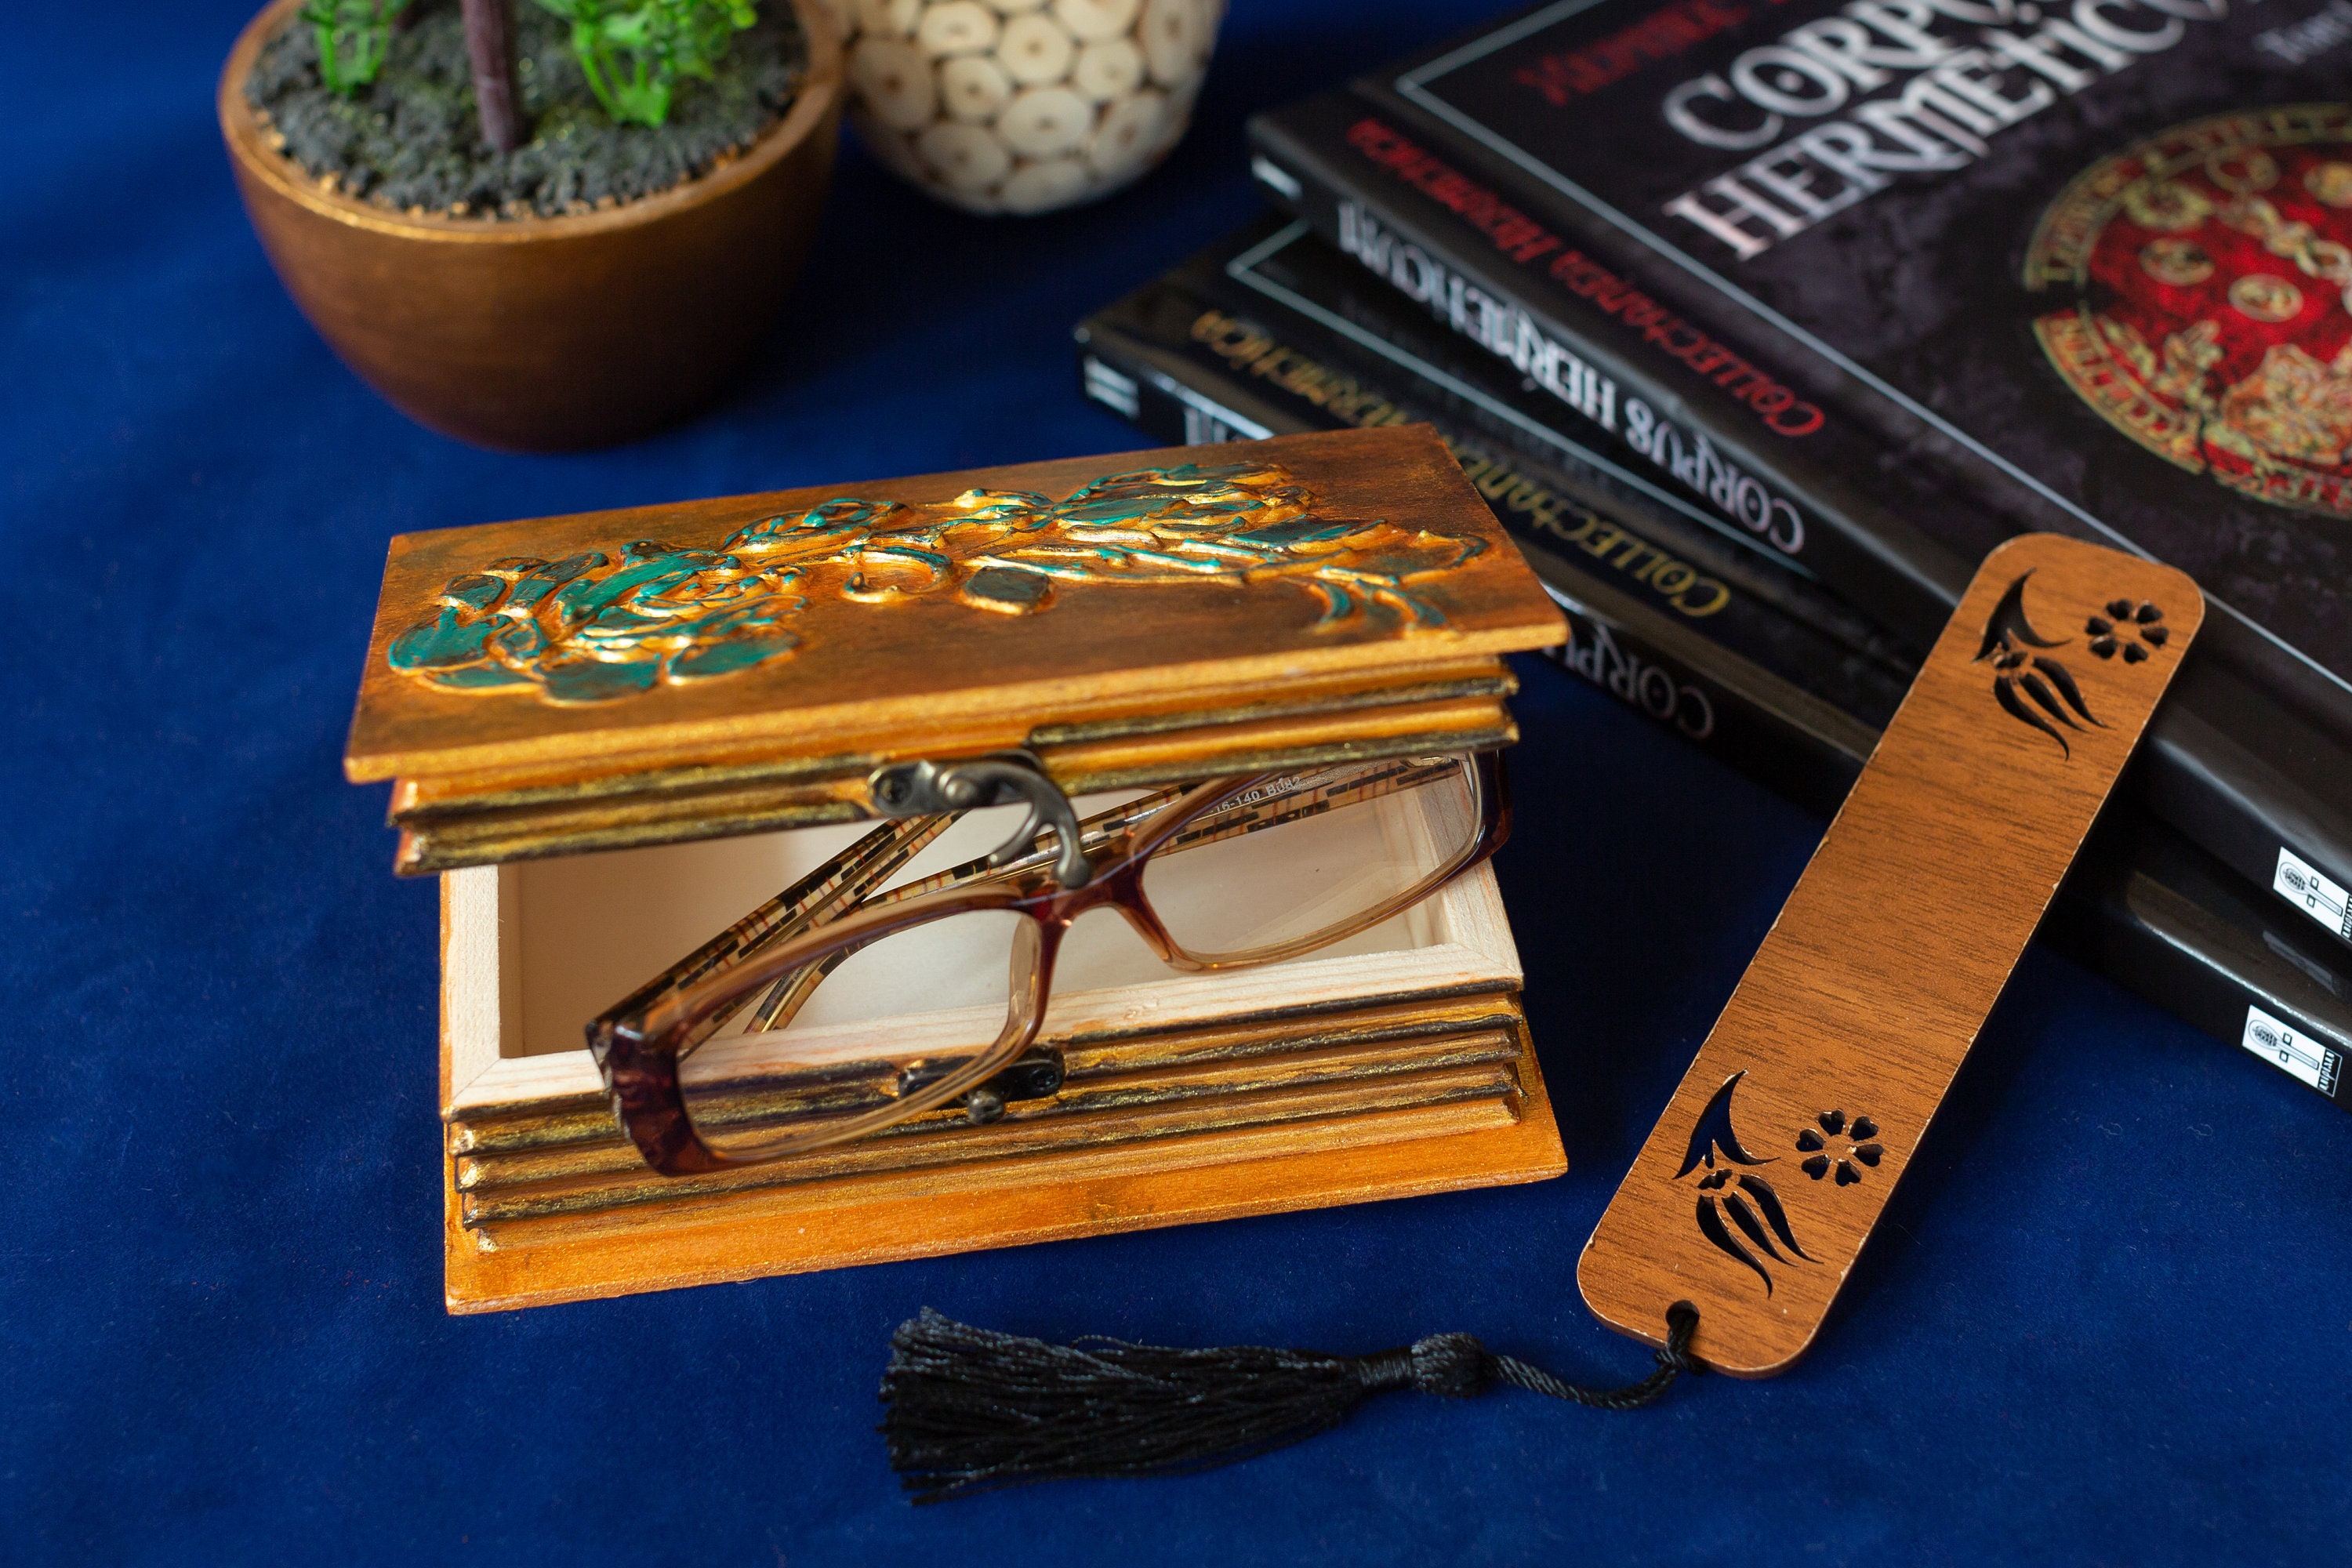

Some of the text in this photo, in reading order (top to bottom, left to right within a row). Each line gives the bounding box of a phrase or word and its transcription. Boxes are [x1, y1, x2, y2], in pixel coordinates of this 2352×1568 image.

[1662, 0, 2230, 260] HERMETIC
[1549, 248, 1826, 437] COLLECTANEA
[1444, 435, 1730, 617] COLLECTANE
[1625, 397, 1805, 554] CORPUS
[1543, 624, 1714, 740] CORP
